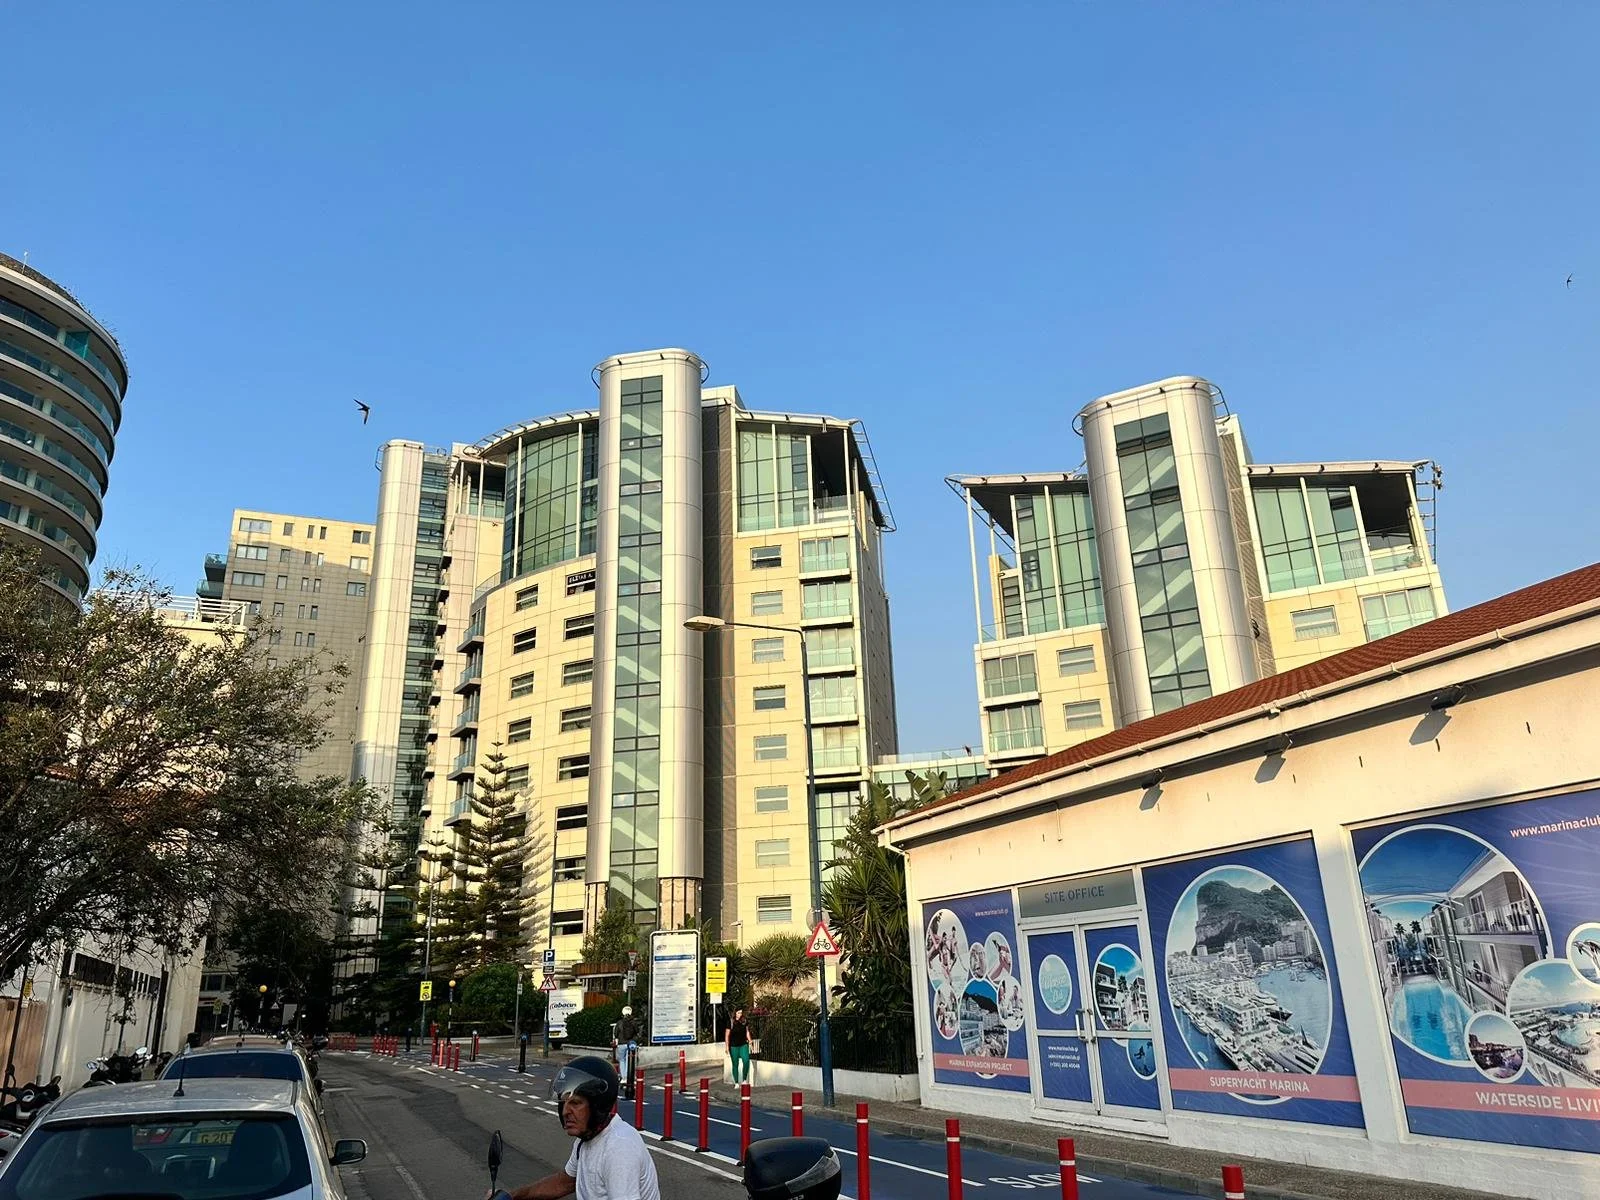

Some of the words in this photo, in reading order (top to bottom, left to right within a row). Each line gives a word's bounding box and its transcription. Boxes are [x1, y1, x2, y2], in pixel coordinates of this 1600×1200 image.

[1044, 891, 1065, 904] SITE
[1067, 885, 1105, 901] OFFICE
[545, 951, 553, 962] P
[966, 1060, 991, 1069] EXPANSION
[991, 1062, 1012, 1071] PROJECT
[1209, 1076, 1267, 1089] SUPERYACHT
[1269, 1079, 1310, 1093] MARINA
[1475, 1091, 1563, 1110] WATERSIDE
[1566, 1096, 1600, 1113] LIVI
